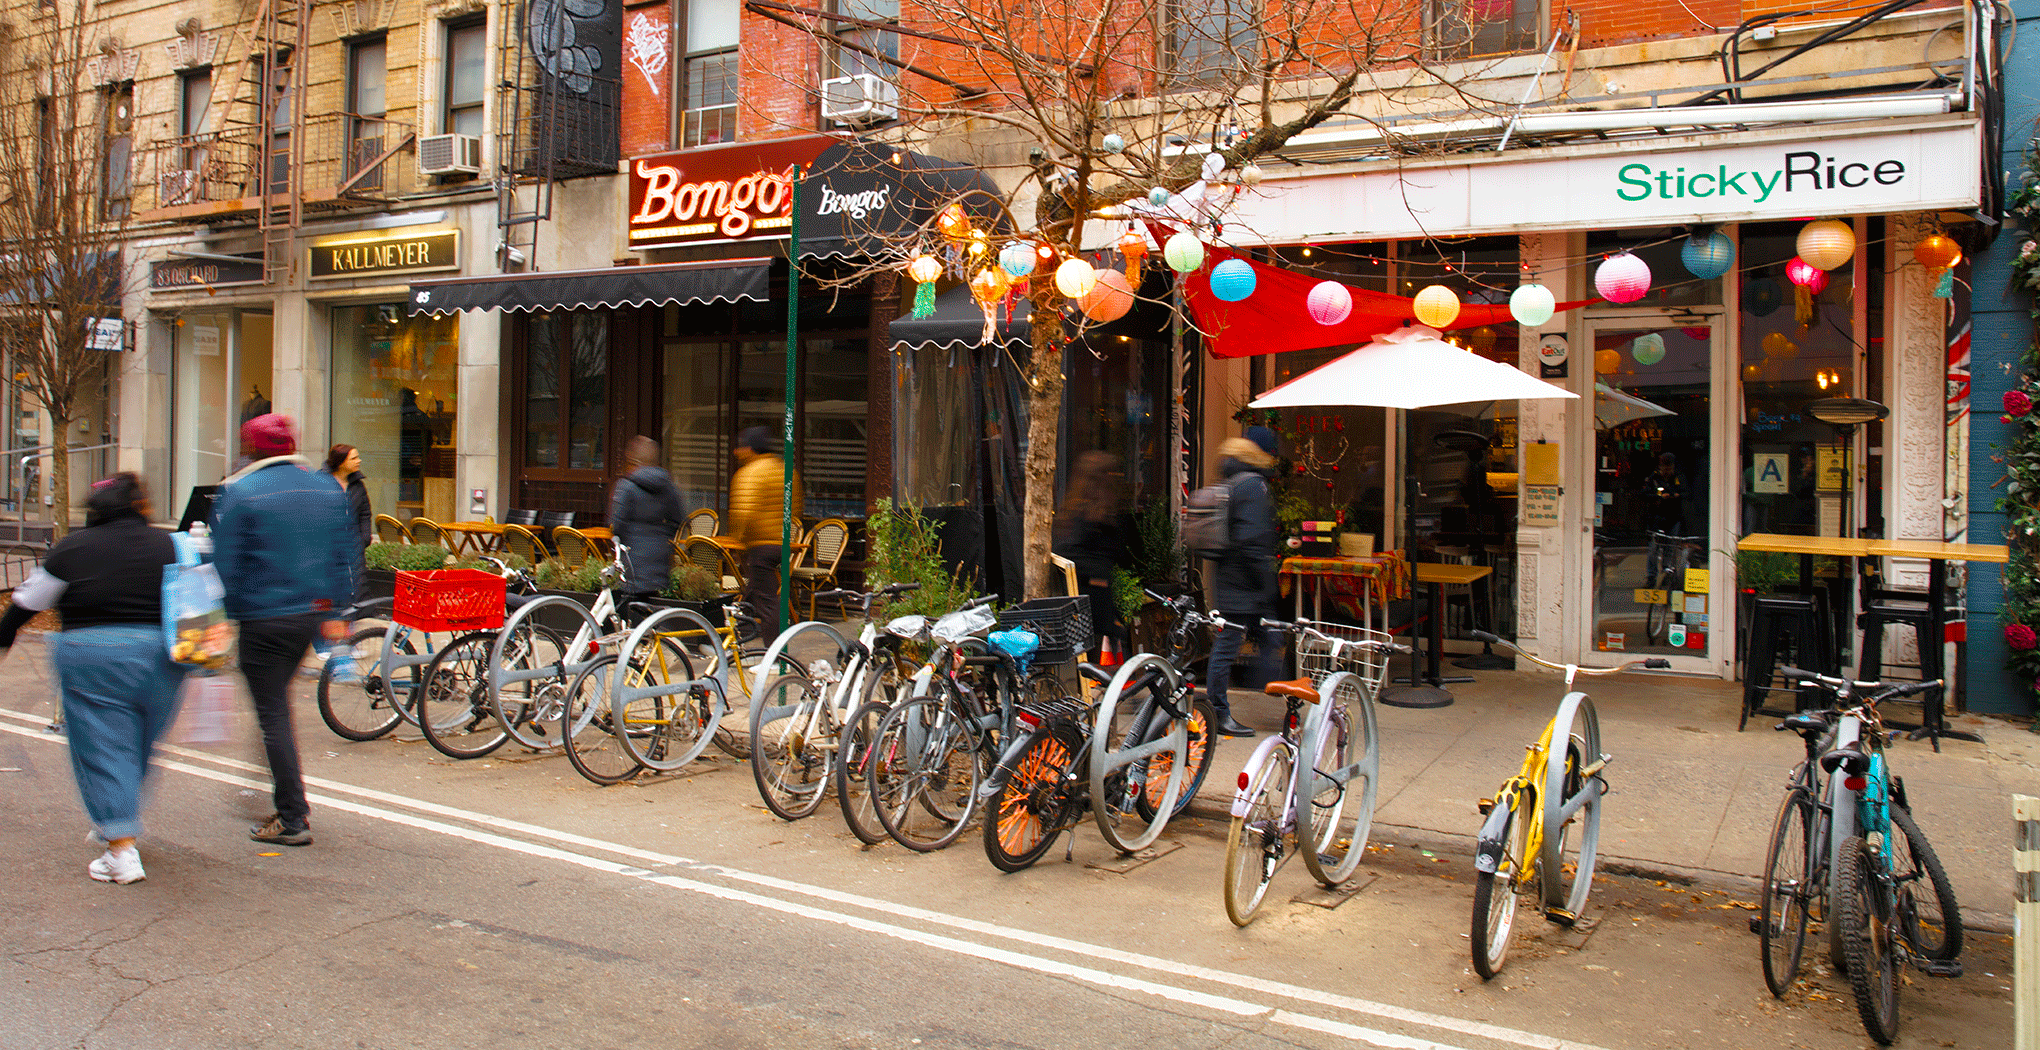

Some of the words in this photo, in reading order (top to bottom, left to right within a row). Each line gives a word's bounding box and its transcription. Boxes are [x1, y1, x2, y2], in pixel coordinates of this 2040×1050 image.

[631, 160, 785, 236] Bongo
[332, 241, 430, 271] KALLMEYER
[156, 268, 171, 286] 83
[171, 264, 219, 285] ORCHARD
[415, 291, 431, 304] 85
[1760, 458, 1782, 482] A
